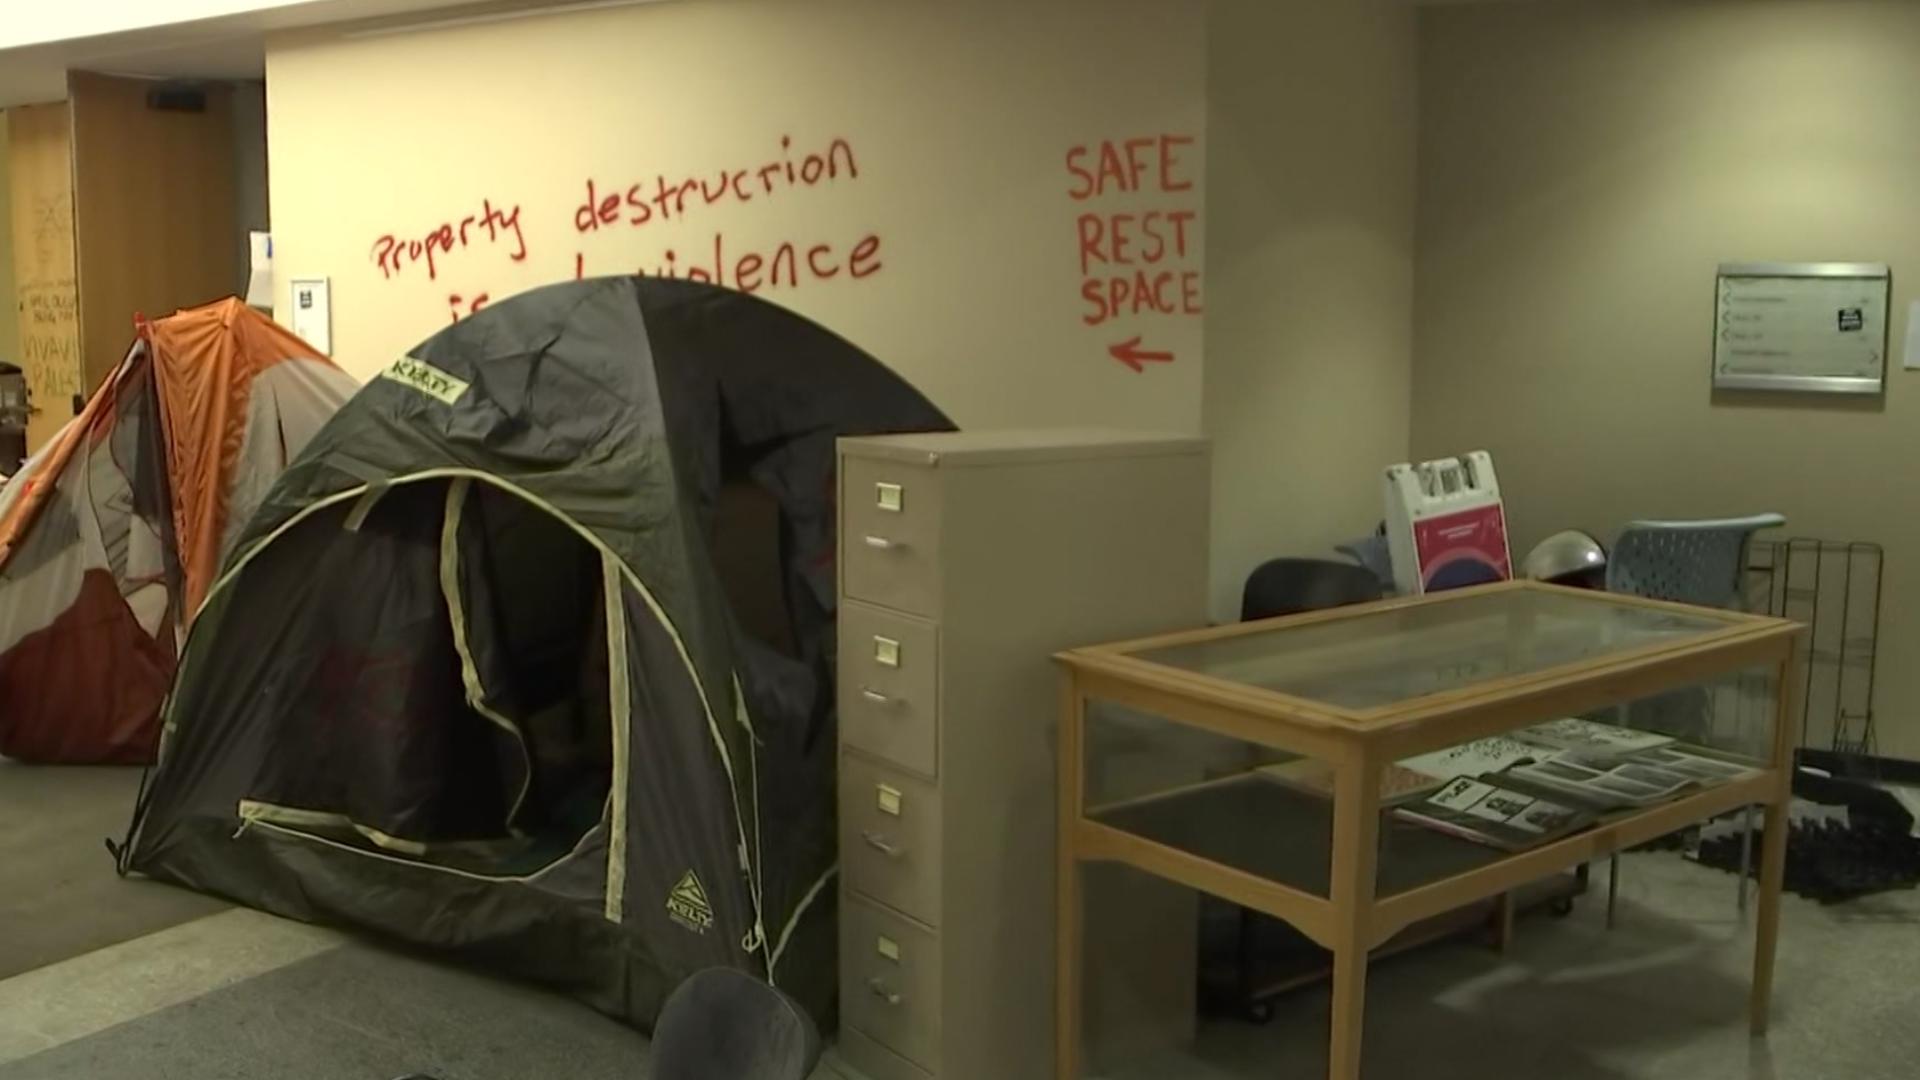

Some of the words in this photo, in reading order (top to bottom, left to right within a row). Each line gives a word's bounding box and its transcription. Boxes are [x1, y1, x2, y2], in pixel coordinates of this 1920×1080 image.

[1066, 135, 1195, 201] SAFE
[373, 200, 527, 280] Property
[574, 135, 859, 234] destruction
[638, 233, 882, 295] iolence
[1077, 211, 1196, 276] REST
[1080, 271, 1204, 327] SPACE
